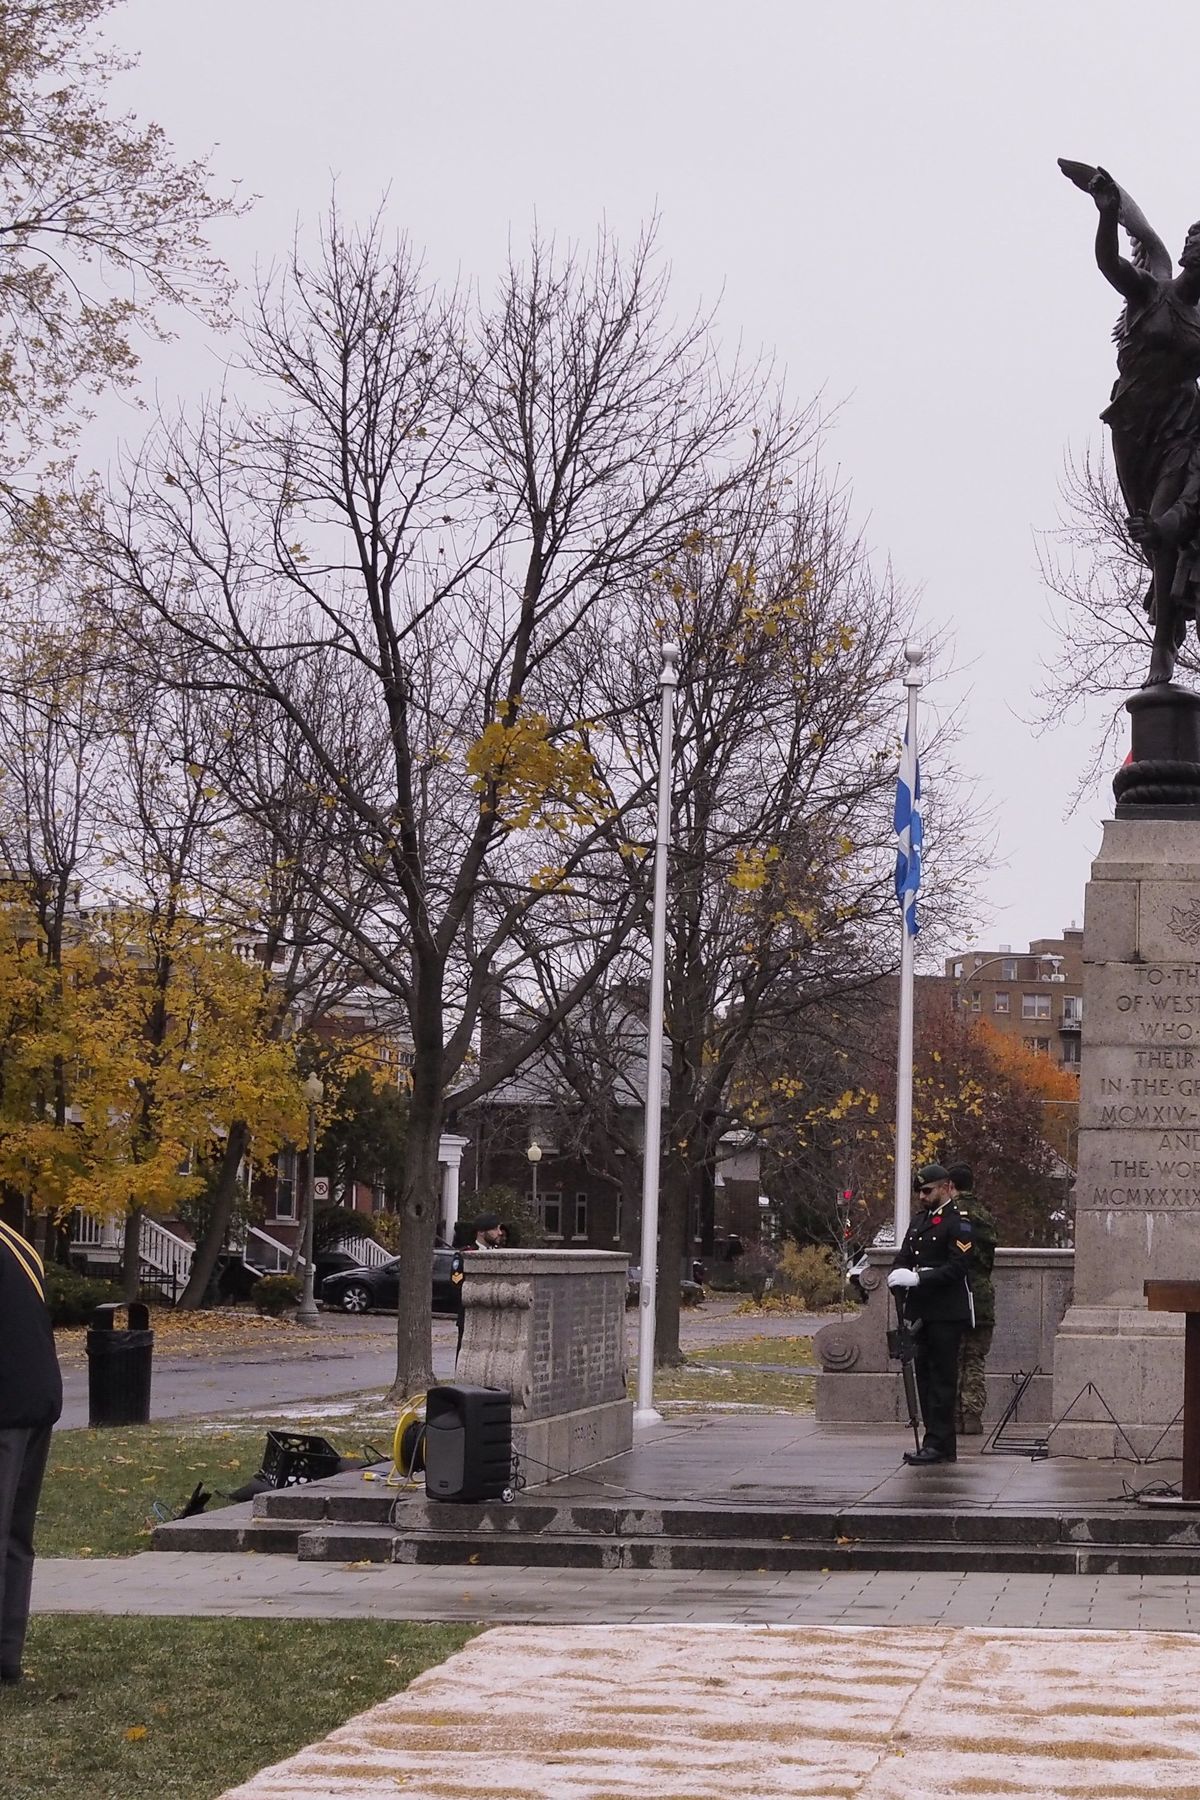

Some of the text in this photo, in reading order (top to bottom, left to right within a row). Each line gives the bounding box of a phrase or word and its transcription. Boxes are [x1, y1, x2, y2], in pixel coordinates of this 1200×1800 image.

[1134, 968, 1164, 986] TO
[1116, 995, 1144, 1012] OF
[1140, 1022, 1193, 1040] WHO
[1135, 1051, 1198, 1070] THEIR
[1100, 1078, 1122, 1095] IN
[1131, 1078, 1170, 1096] THE
[1110, 1160, 1150, 1178] THE
